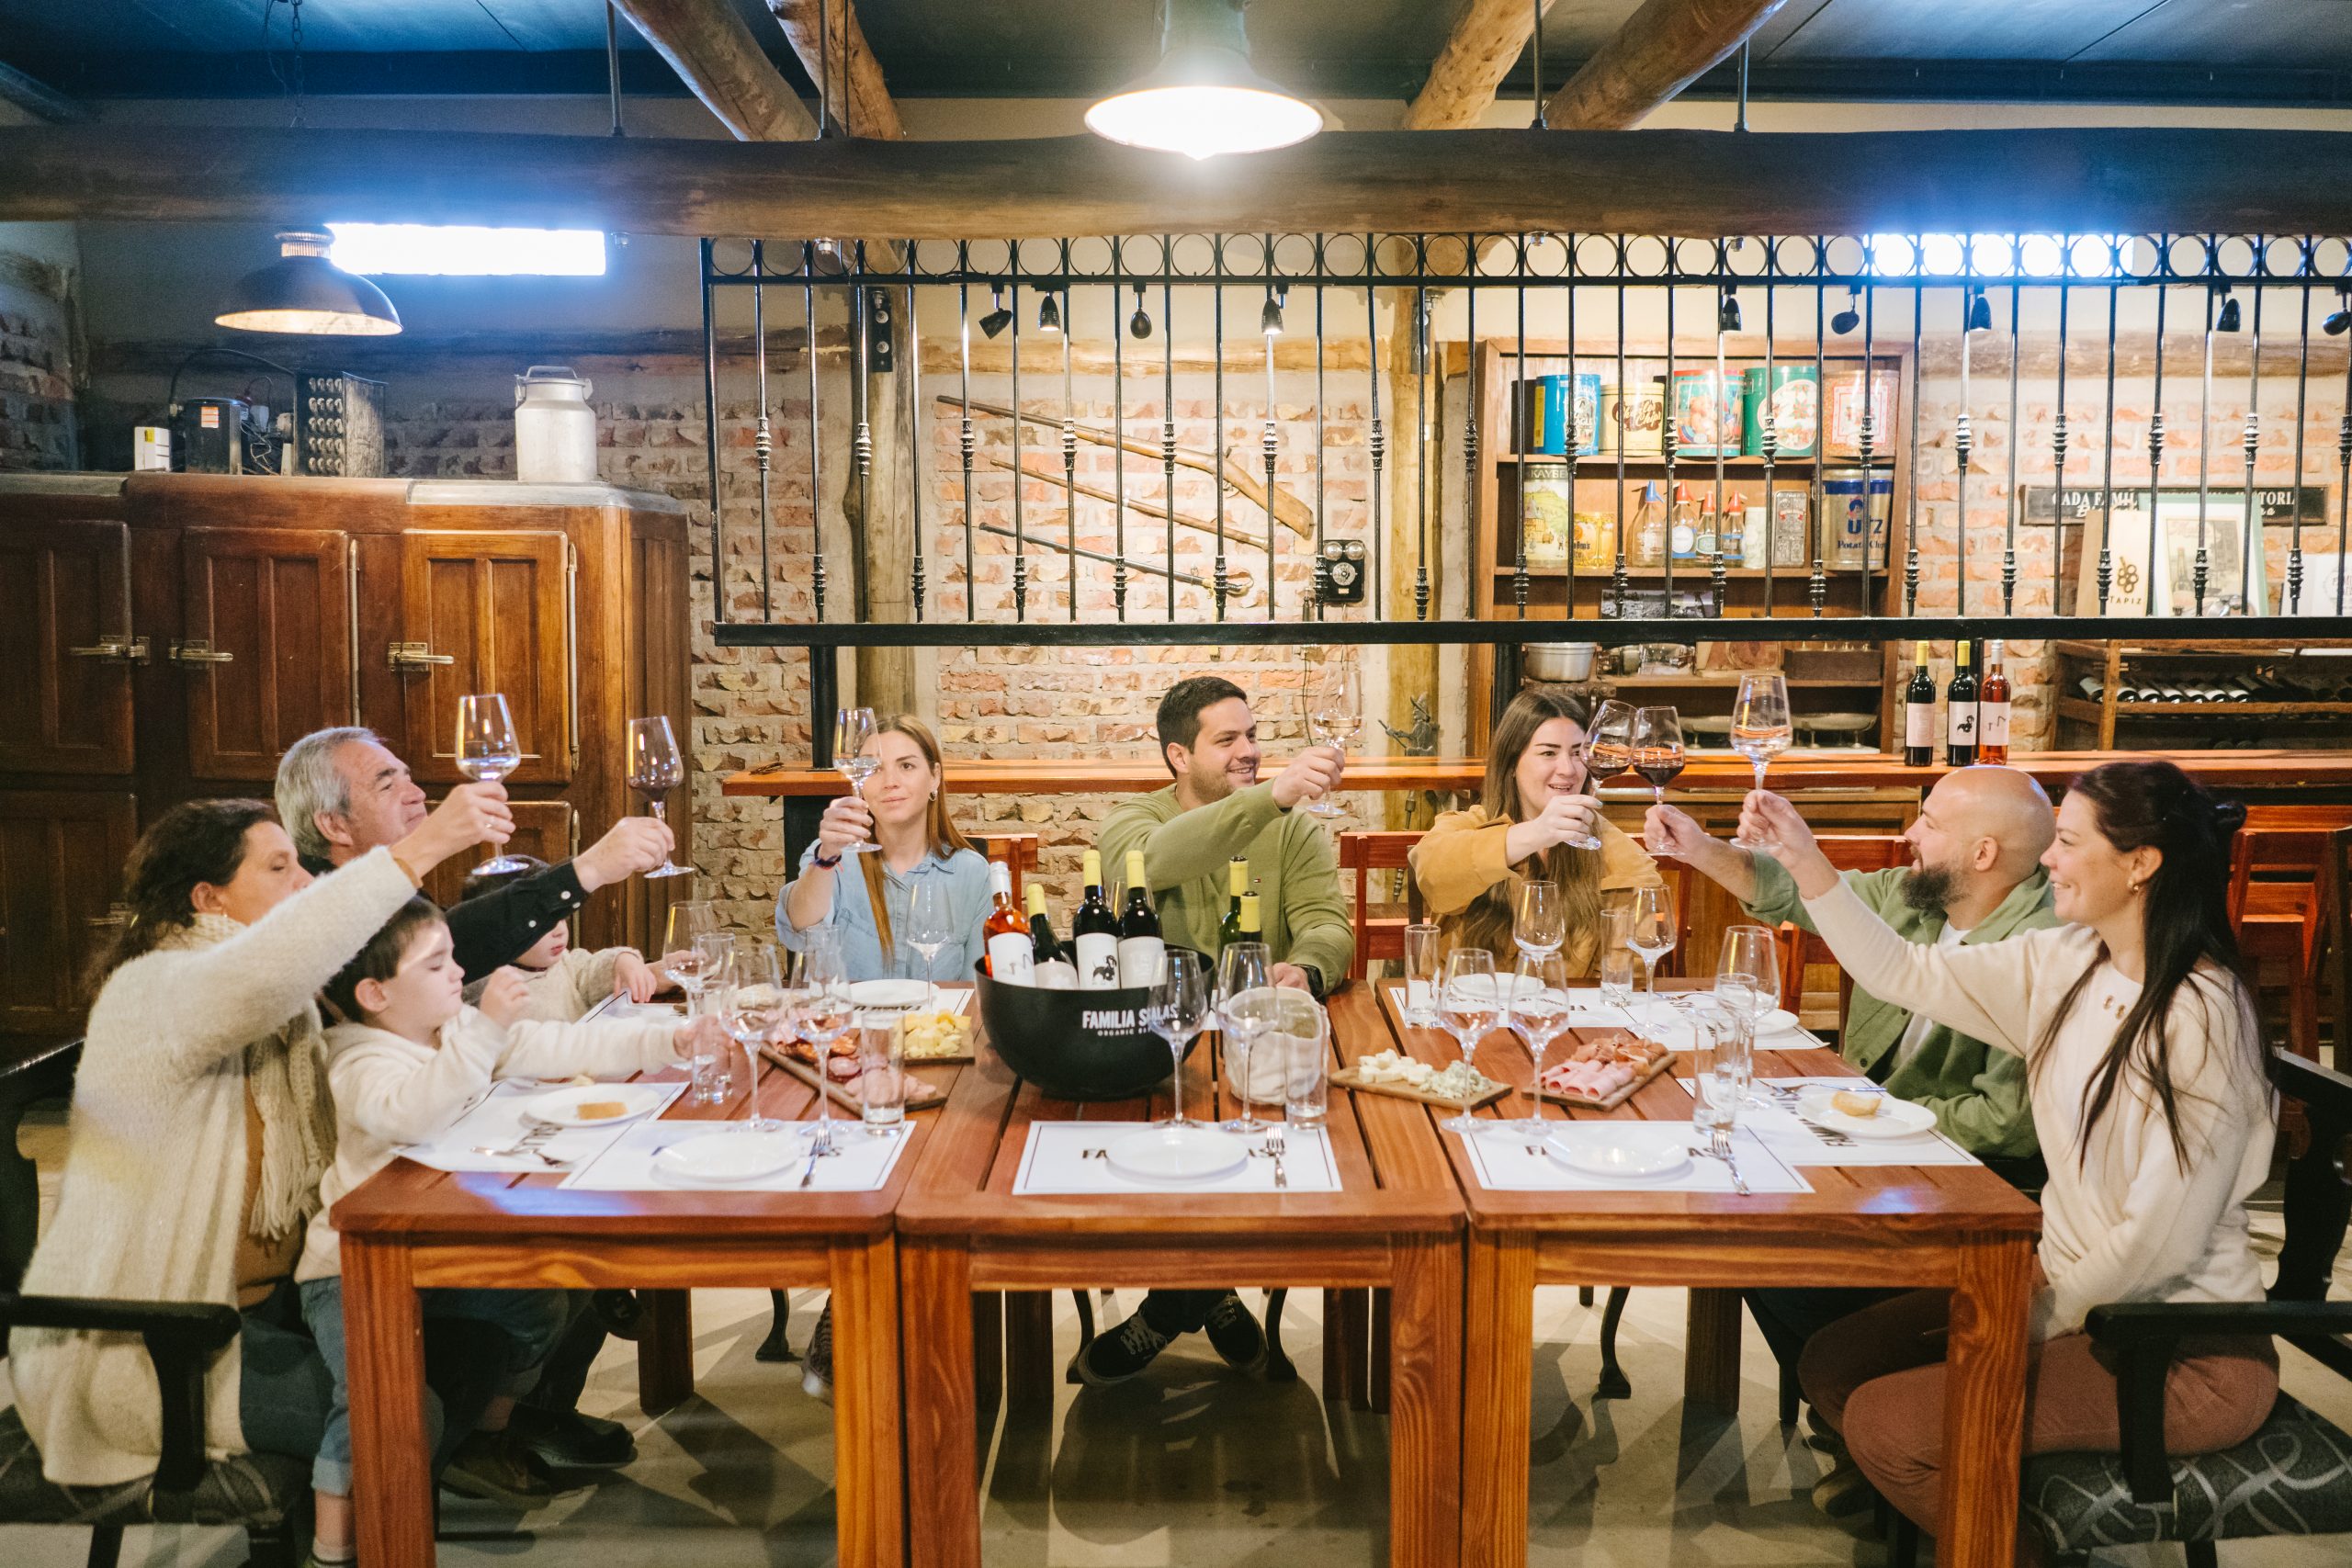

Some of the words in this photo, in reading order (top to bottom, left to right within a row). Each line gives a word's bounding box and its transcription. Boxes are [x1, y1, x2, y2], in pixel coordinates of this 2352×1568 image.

[1531, 469, 1568, 479] KAYSE
[1838, 540, 1863, 549] Potat
[2109, 595, 2142, 604] TAPIZ
[1082, 1010, 1136, 1030] FAMILIA
[1097, 1029, 1135, 1037] ORGANIC
